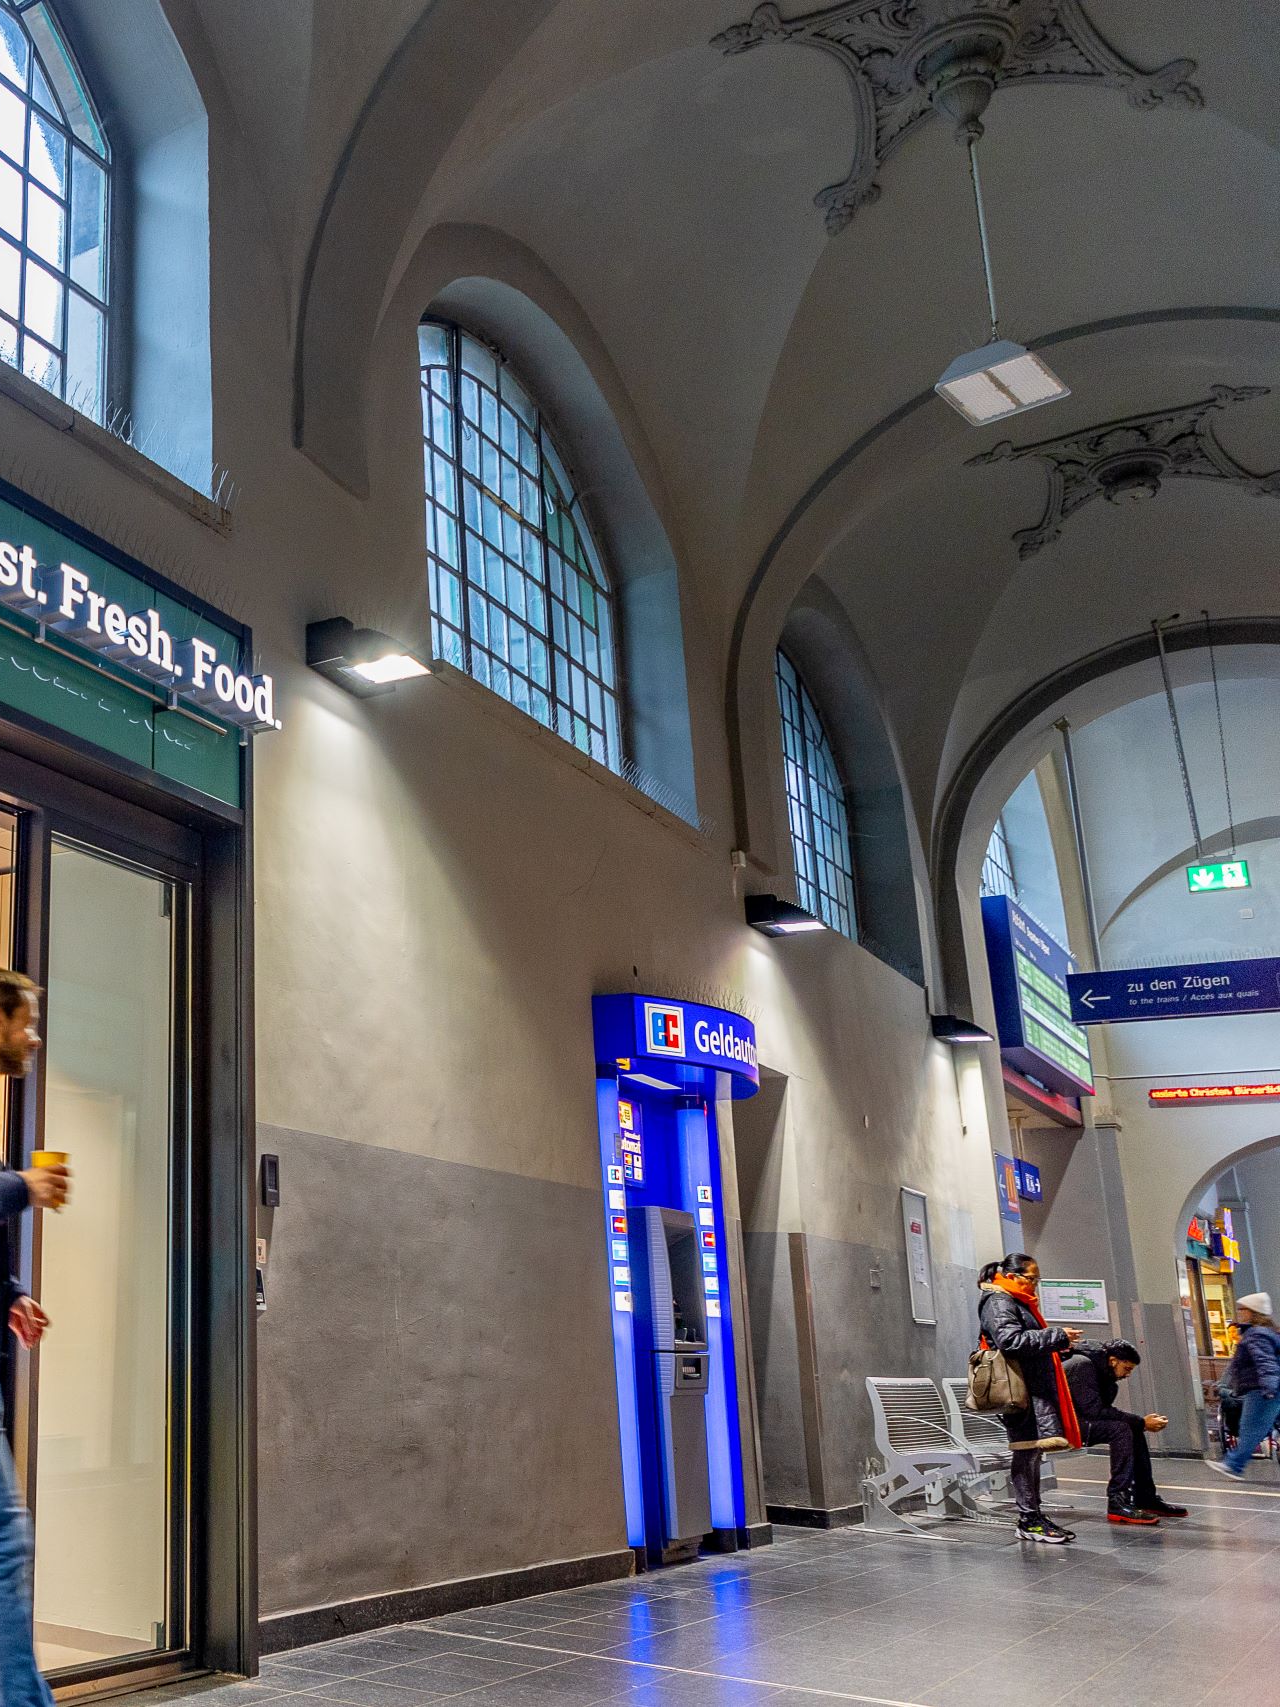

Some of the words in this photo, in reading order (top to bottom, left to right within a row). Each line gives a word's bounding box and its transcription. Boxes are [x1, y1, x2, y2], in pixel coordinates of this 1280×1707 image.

[59, 562, 182, 676] Fresh.
[191, 637, 282, 730] Food.
[1127, 983, 1144, 993] zu
[1150, 979, 1177, 991] den
[1182, 975, 1230, 989] Zügen
